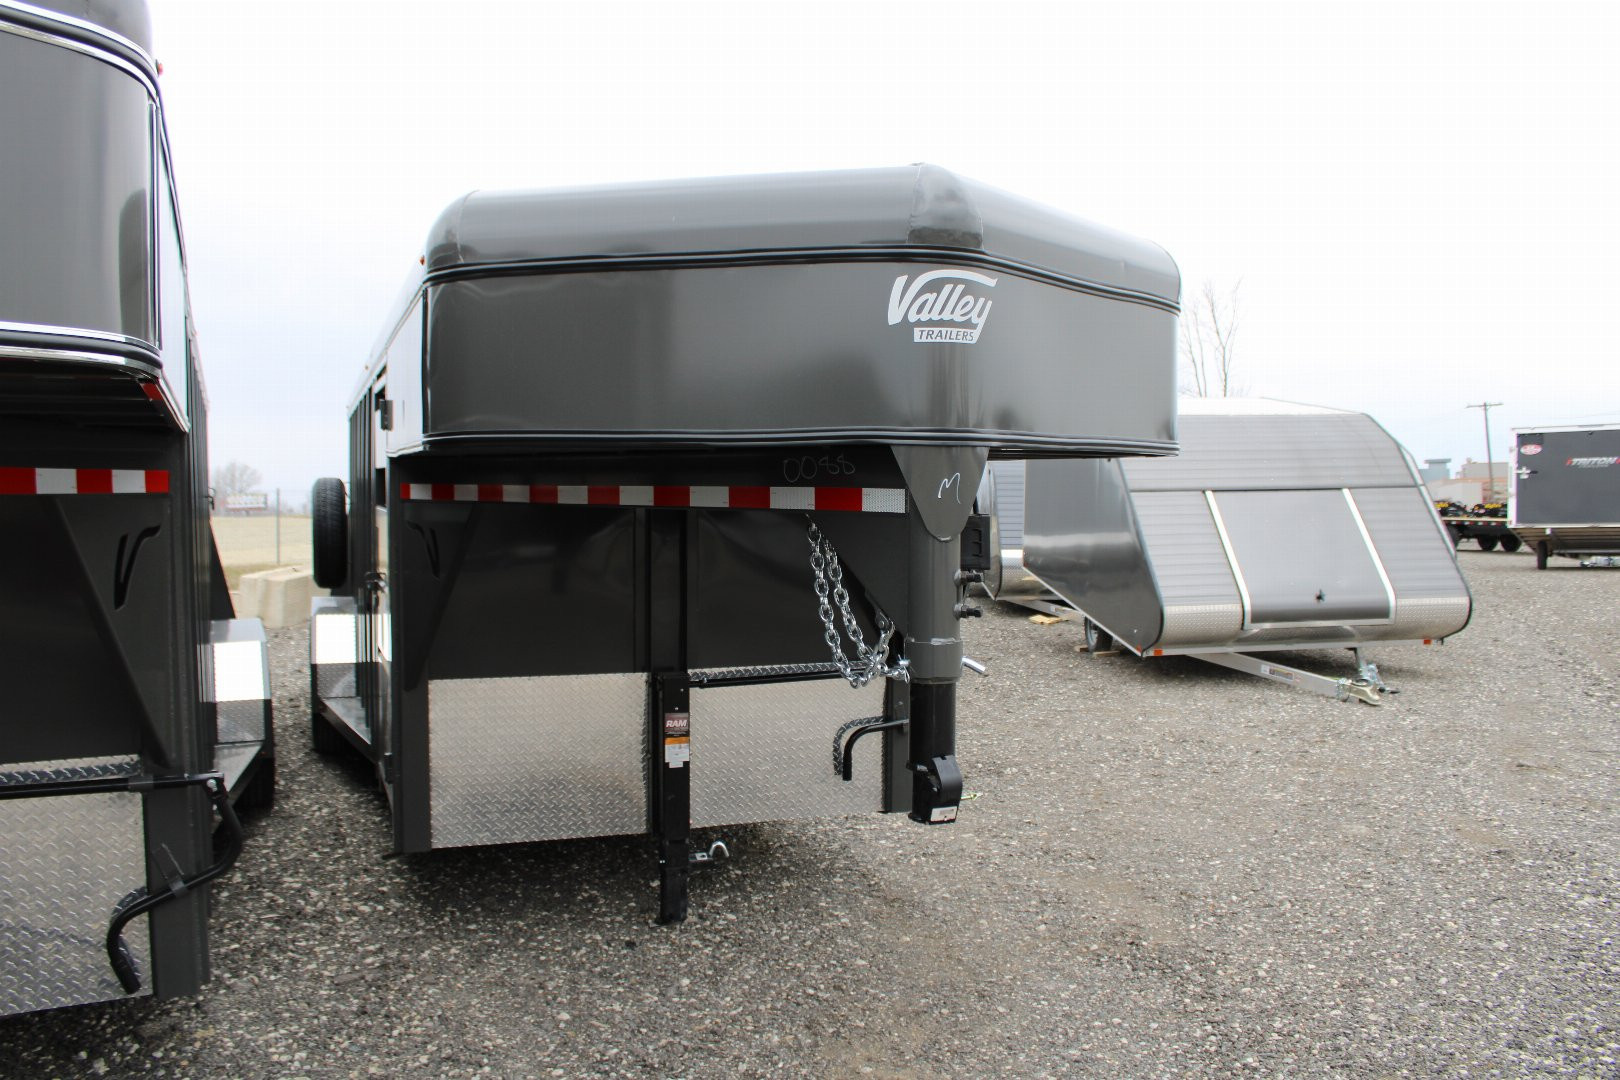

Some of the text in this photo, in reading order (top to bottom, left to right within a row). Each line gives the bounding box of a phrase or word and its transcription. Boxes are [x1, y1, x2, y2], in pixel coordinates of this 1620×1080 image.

[888, 269, 998, 343] Valley
[918, 329, 974, 342] TRAILERS
[665, 719, 688, 728] RAM
